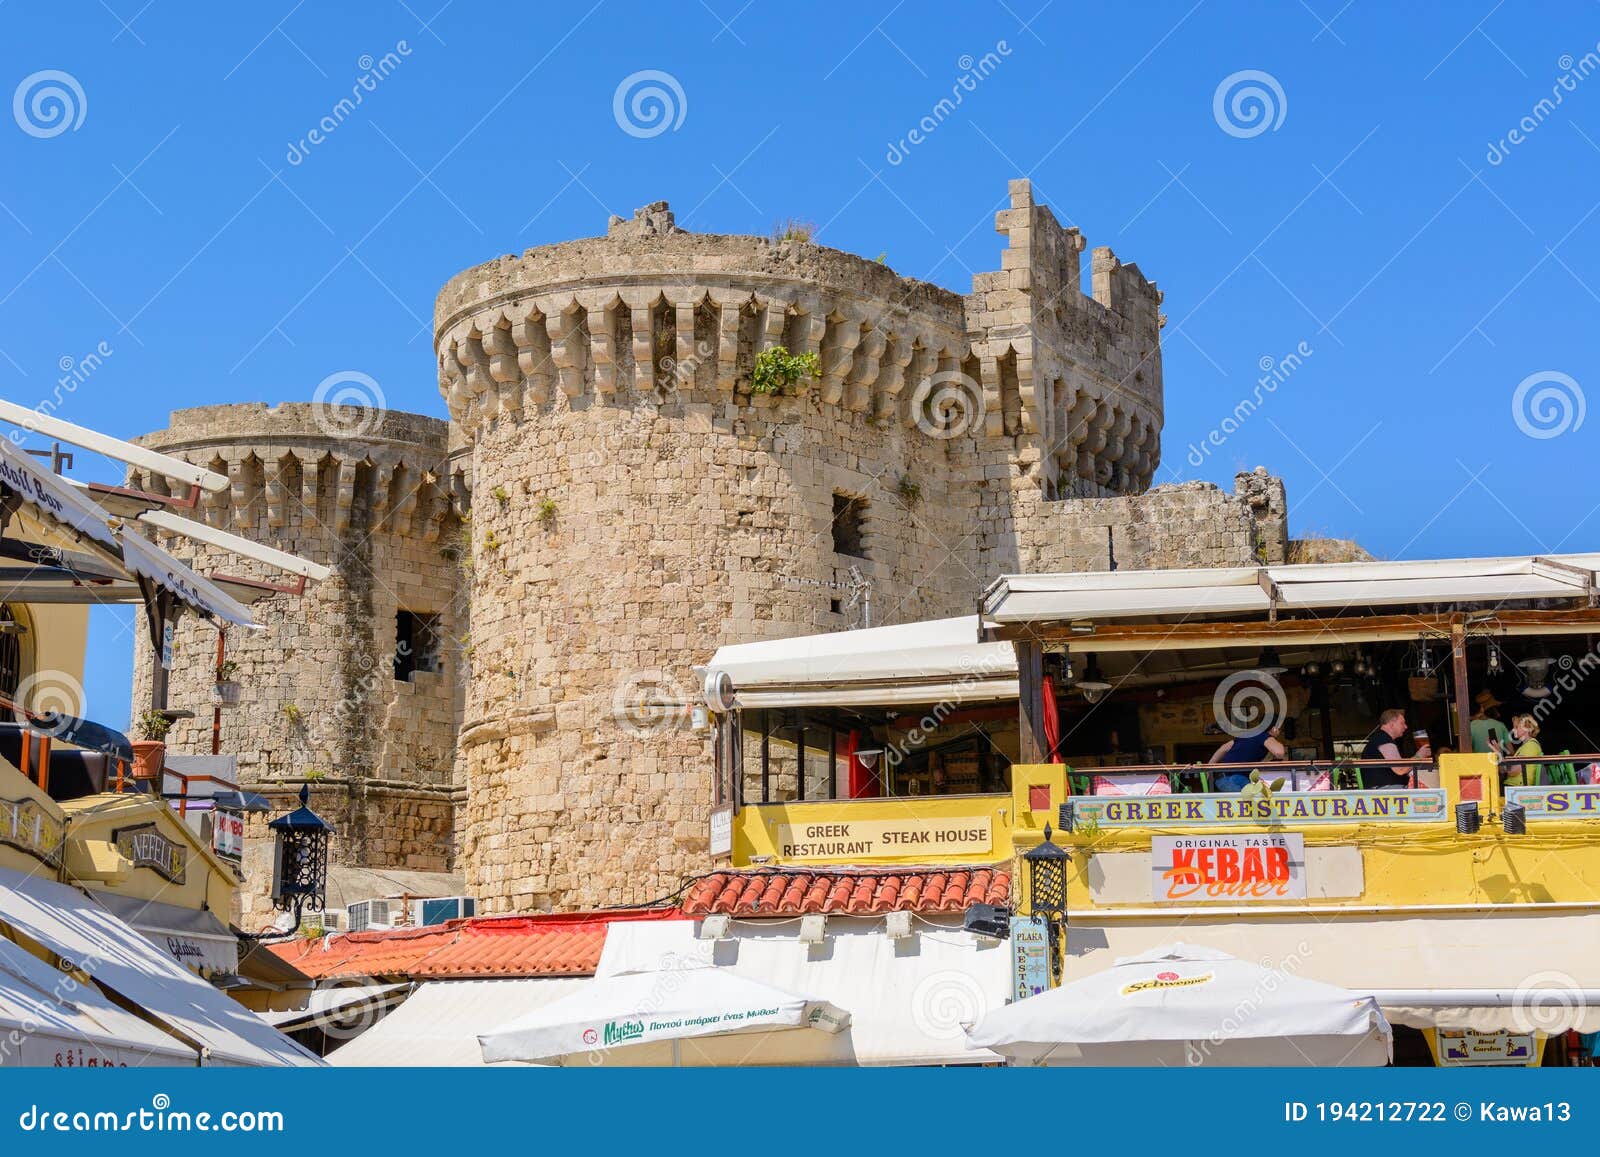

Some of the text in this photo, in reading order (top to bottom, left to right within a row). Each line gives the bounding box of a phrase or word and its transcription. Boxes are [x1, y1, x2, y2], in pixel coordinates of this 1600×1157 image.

[1106, 797, 1409, 820] GREEK RESTAURANT
[806, 825, 850, 838] GREEK
[882, 829, 987, 844] STEAK HOUSE
[783, 841, 873, 857] RESTAURANT
[1175, 838, 1286, 848] ORIGINAL TASTE
[1172, 847, 1290, 885] KEBAB
[1017, 932, 1043, 941] PLAKA
[604, 1020, 645, 1046] Mythos
